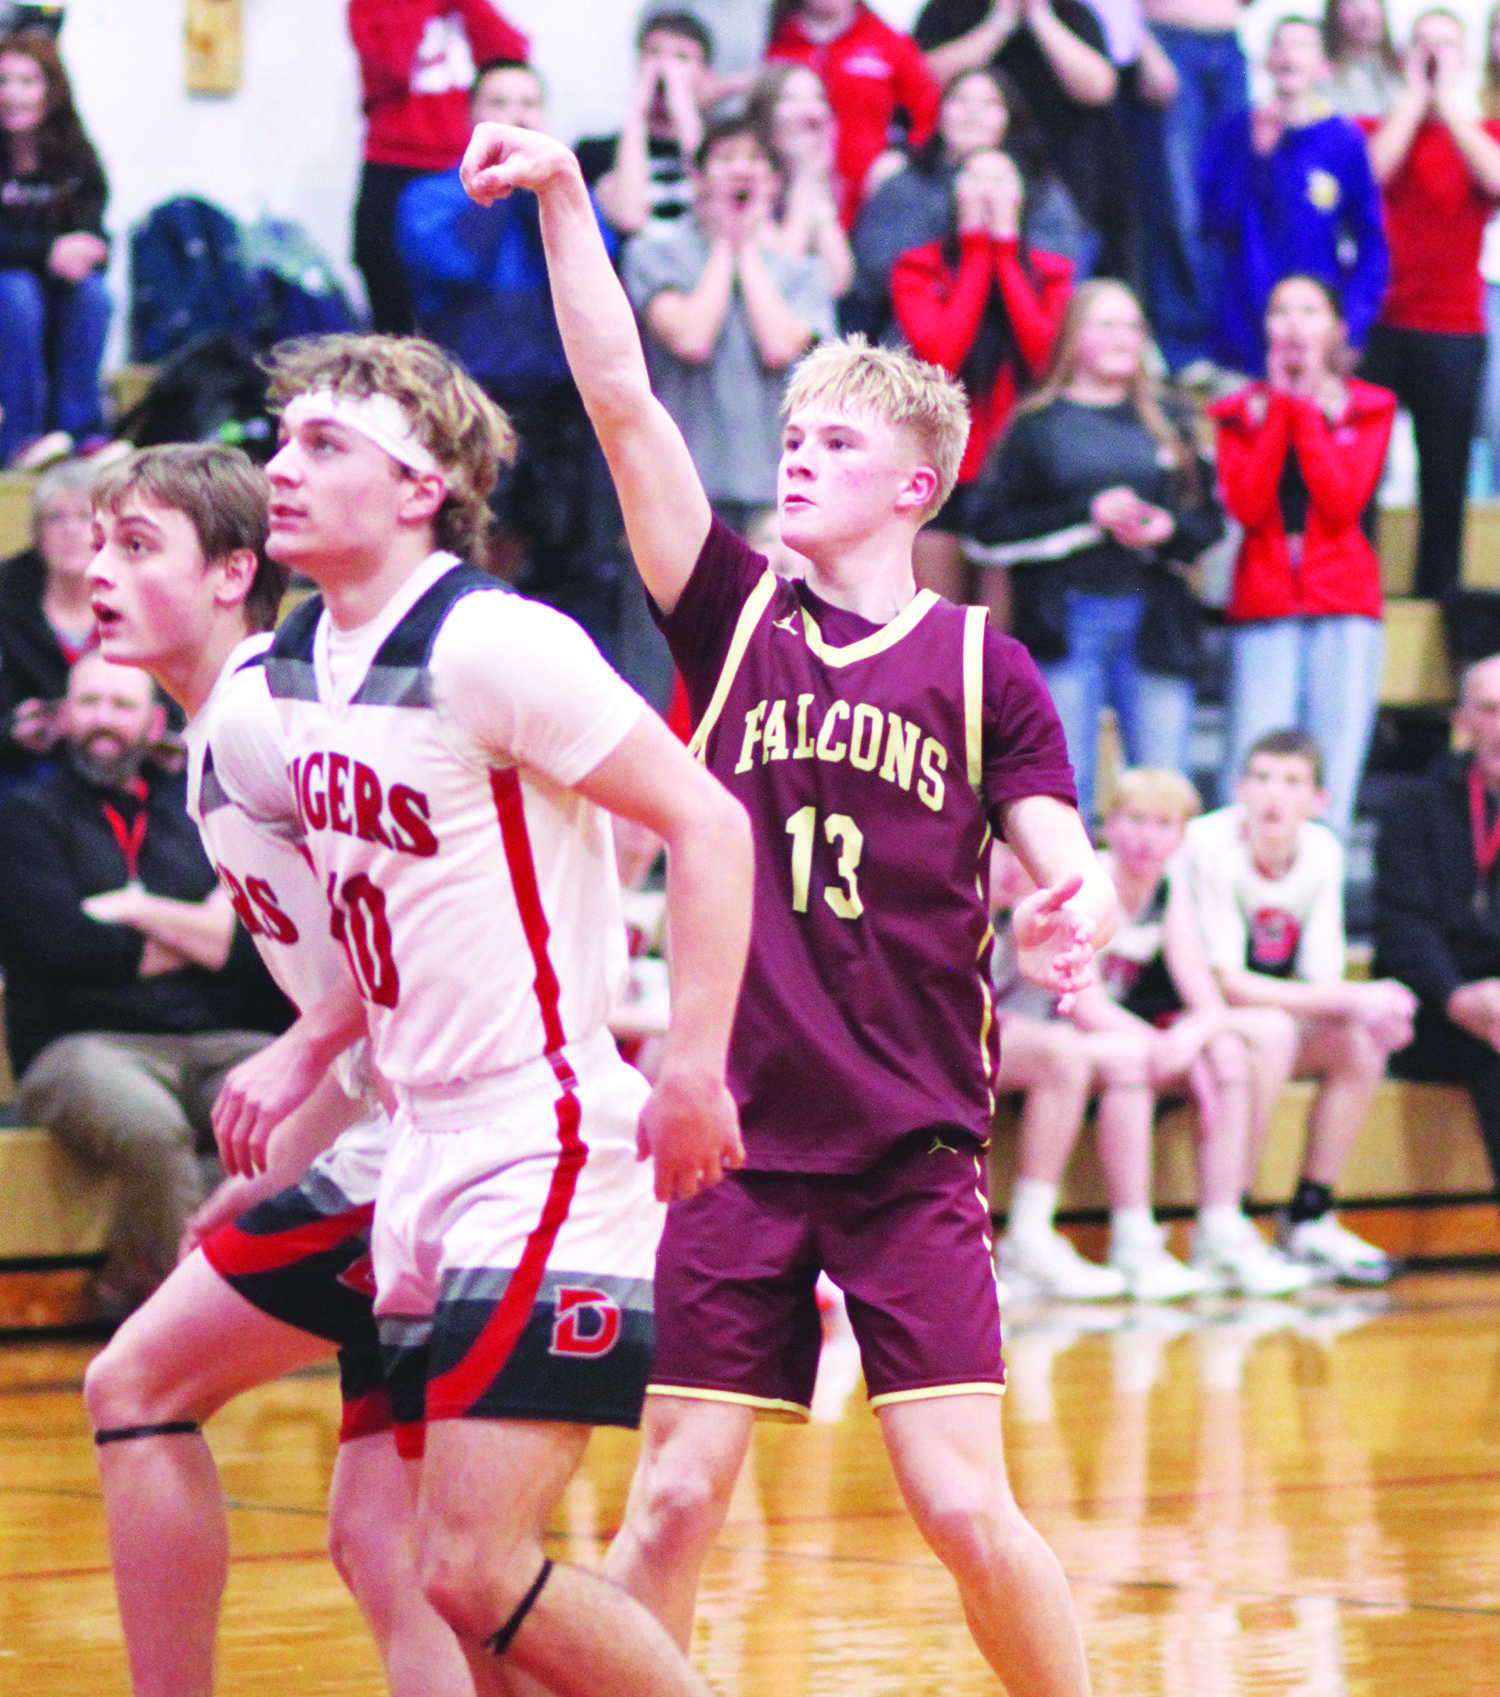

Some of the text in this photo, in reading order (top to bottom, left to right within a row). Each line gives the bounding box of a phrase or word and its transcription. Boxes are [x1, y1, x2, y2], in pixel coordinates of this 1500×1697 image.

[286, 750, 439, 858] IGERS
[734, 692, 949, 812] FALCONS
[784, 804, 865, 920] 13
[548, 1284, 622, 1359] D
